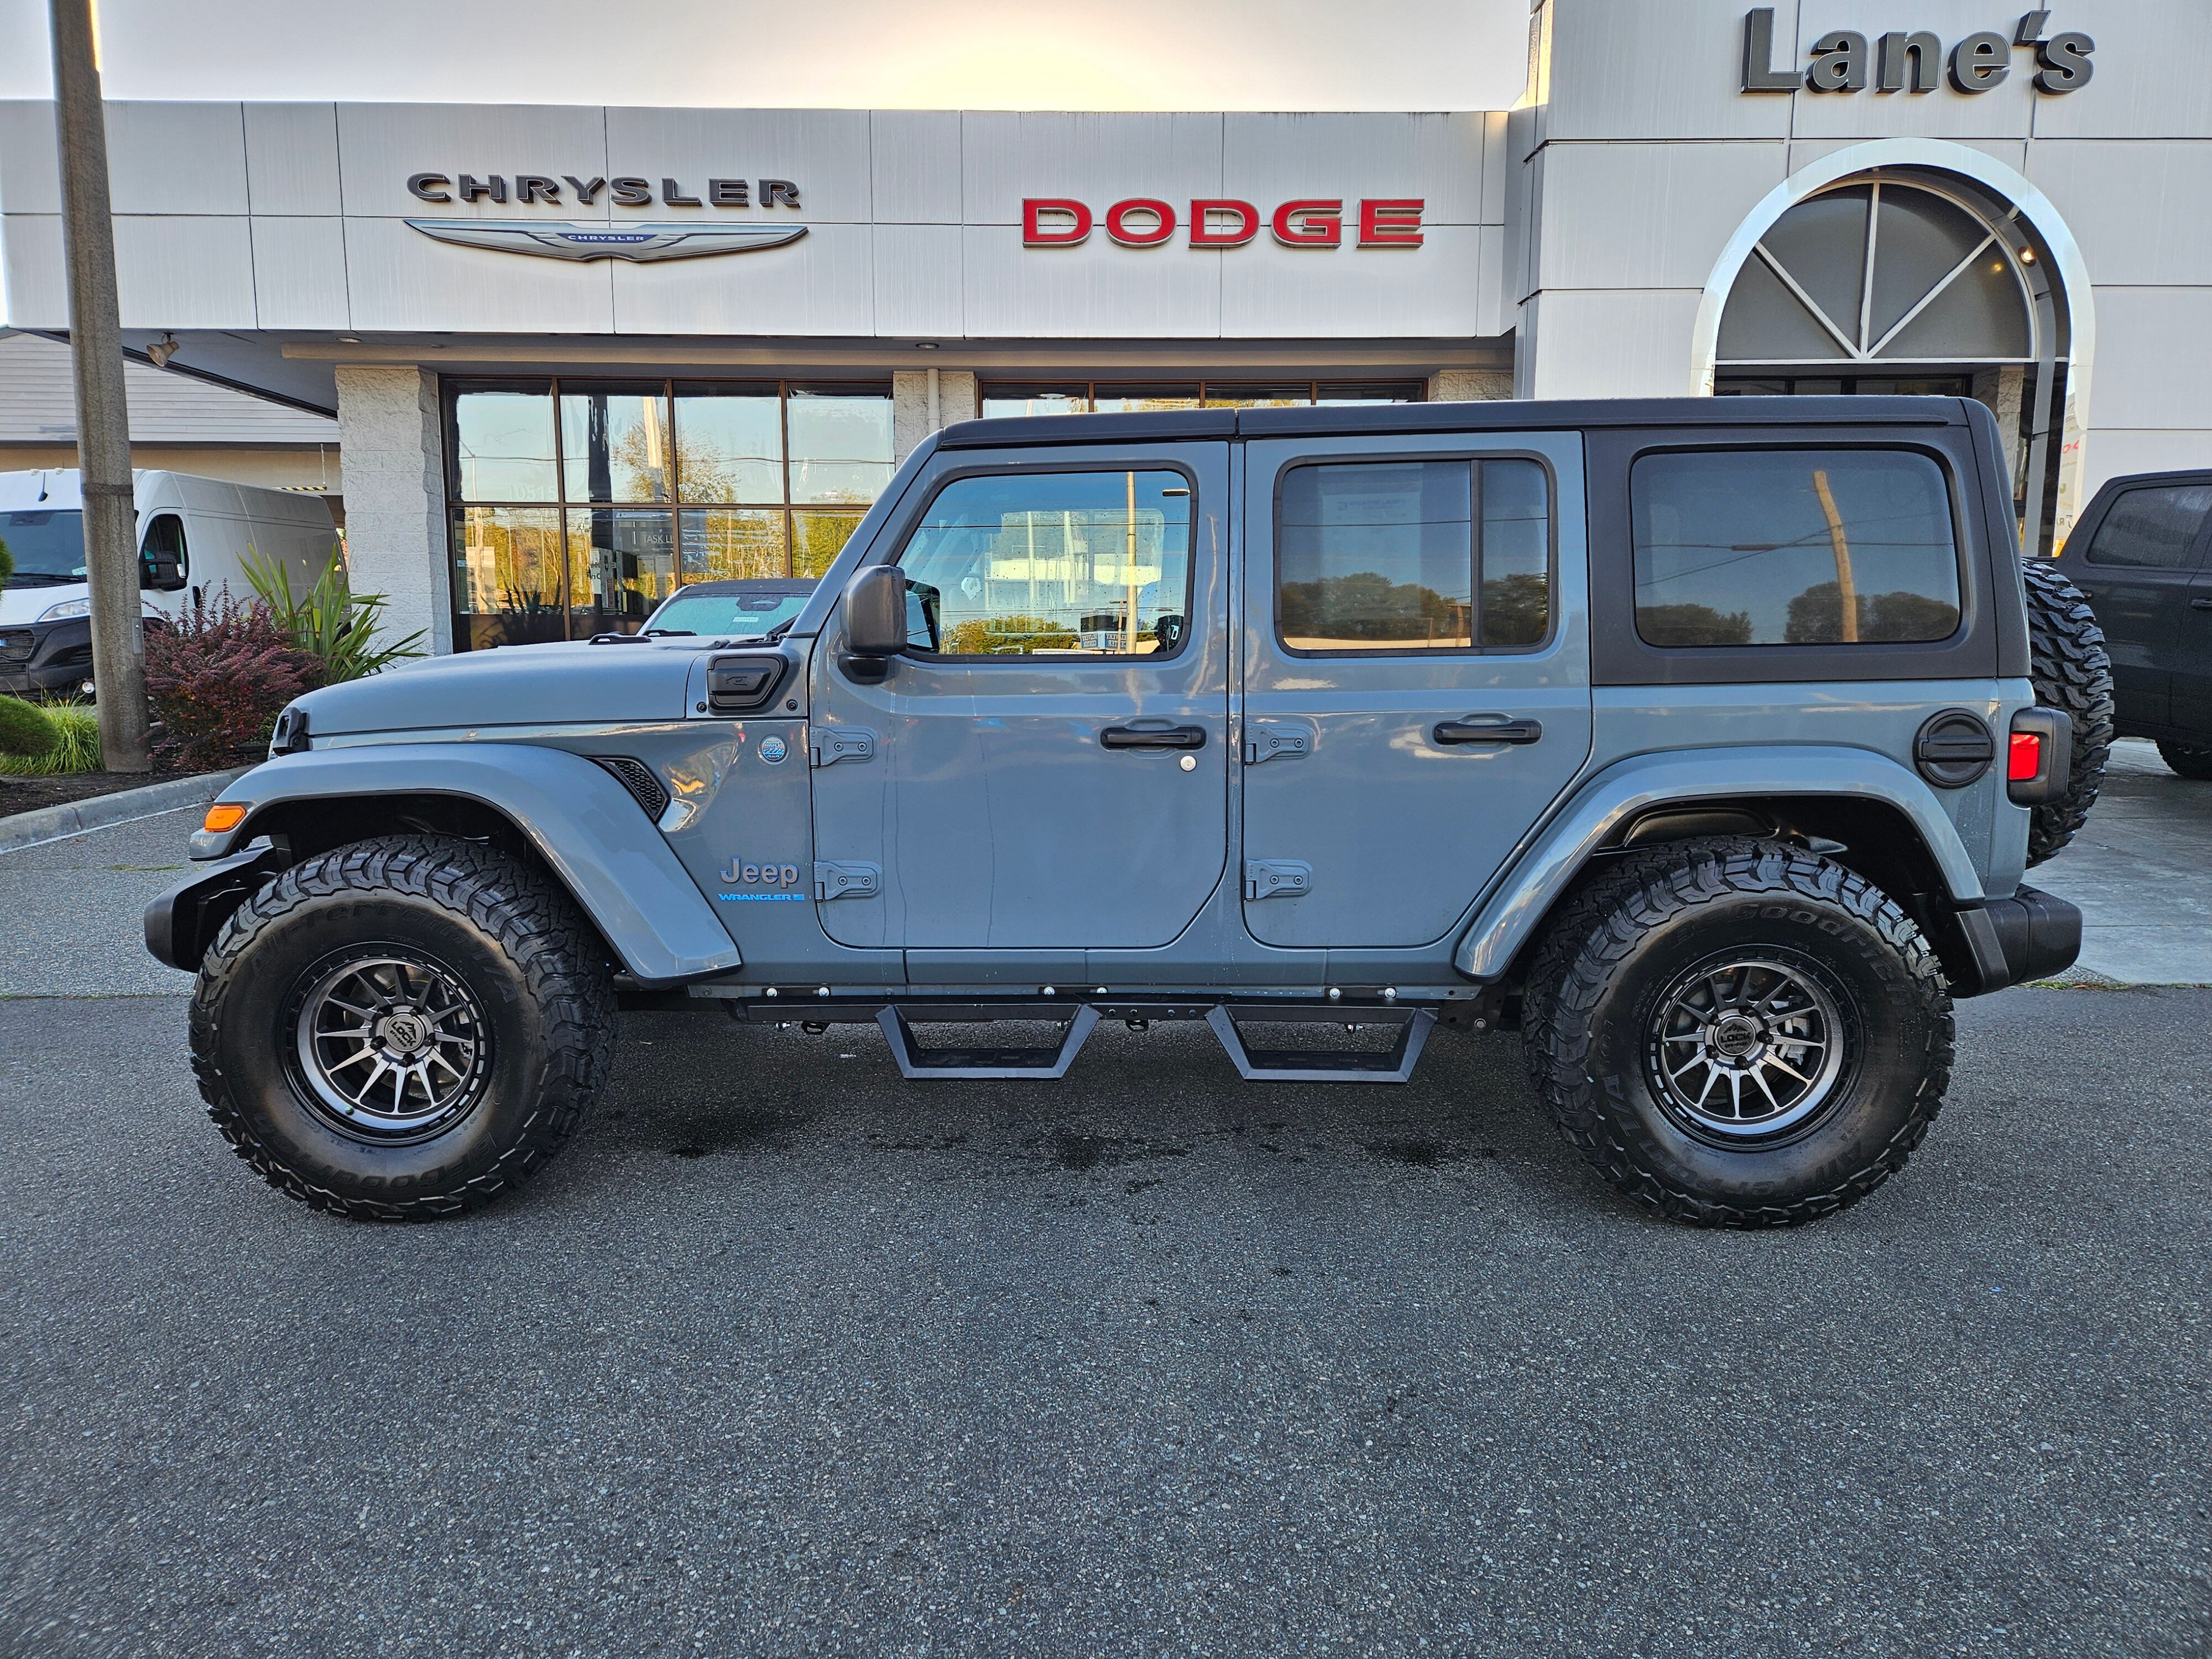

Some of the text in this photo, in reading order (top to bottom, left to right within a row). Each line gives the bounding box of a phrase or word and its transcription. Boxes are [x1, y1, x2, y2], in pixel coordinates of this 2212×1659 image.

[1741, 7, 2095, 95] Lane's
[406, 173, 801, 208] CHRYSLER
[1022, 198, 1425, 248] DODGE
[506, 486, 556, 500] 10515
[643, 535, 664, 544] TASK
[720, 858, 799, 889] Jeep
[391, 1021, 416, 1046] LOCK
[1720, 1032, 1751, 1043] LOCK
